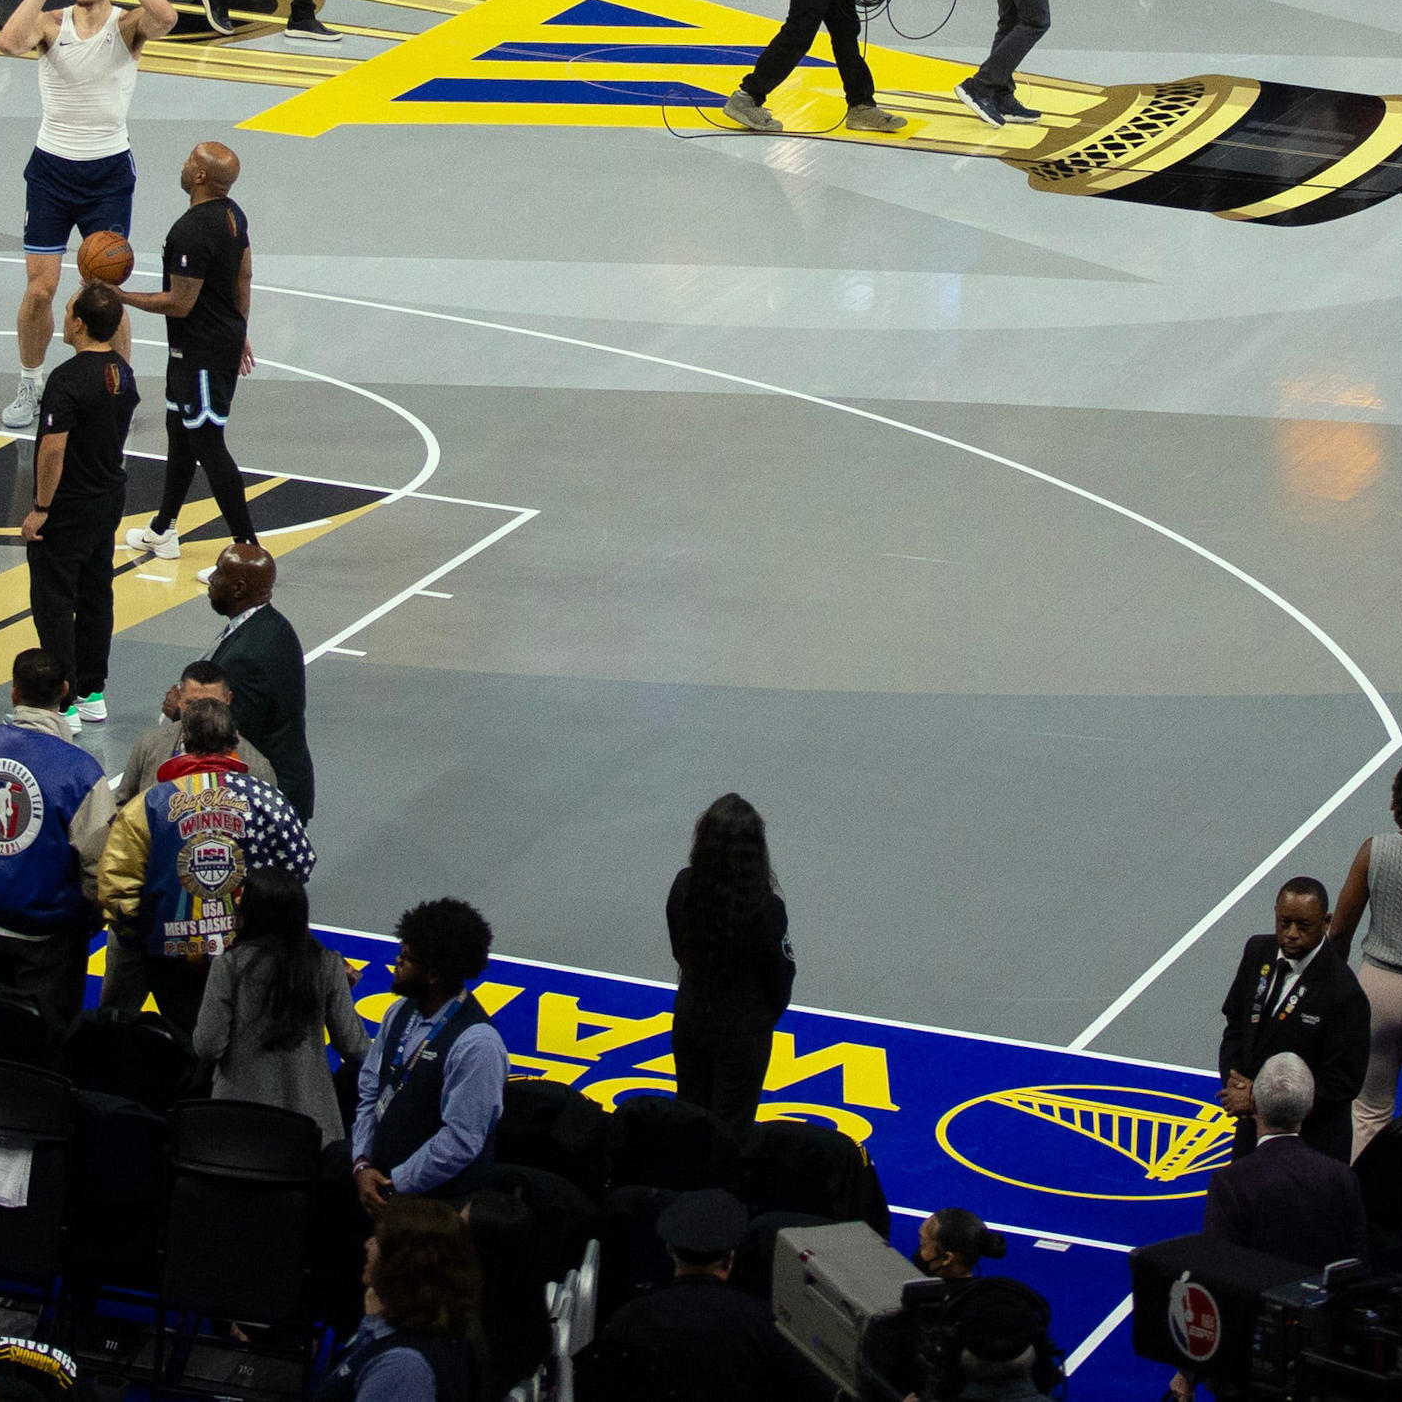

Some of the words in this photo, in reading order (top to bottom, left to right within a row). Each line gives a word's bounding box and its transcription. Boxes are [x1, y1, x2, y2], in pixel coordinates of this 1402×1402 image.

[180, 812, 244, 839] WINNER
[202, 901, 225, 918] USA
[164, 920, 198, 937] MEN'S
[164, 939, 218, 956] PARIS
